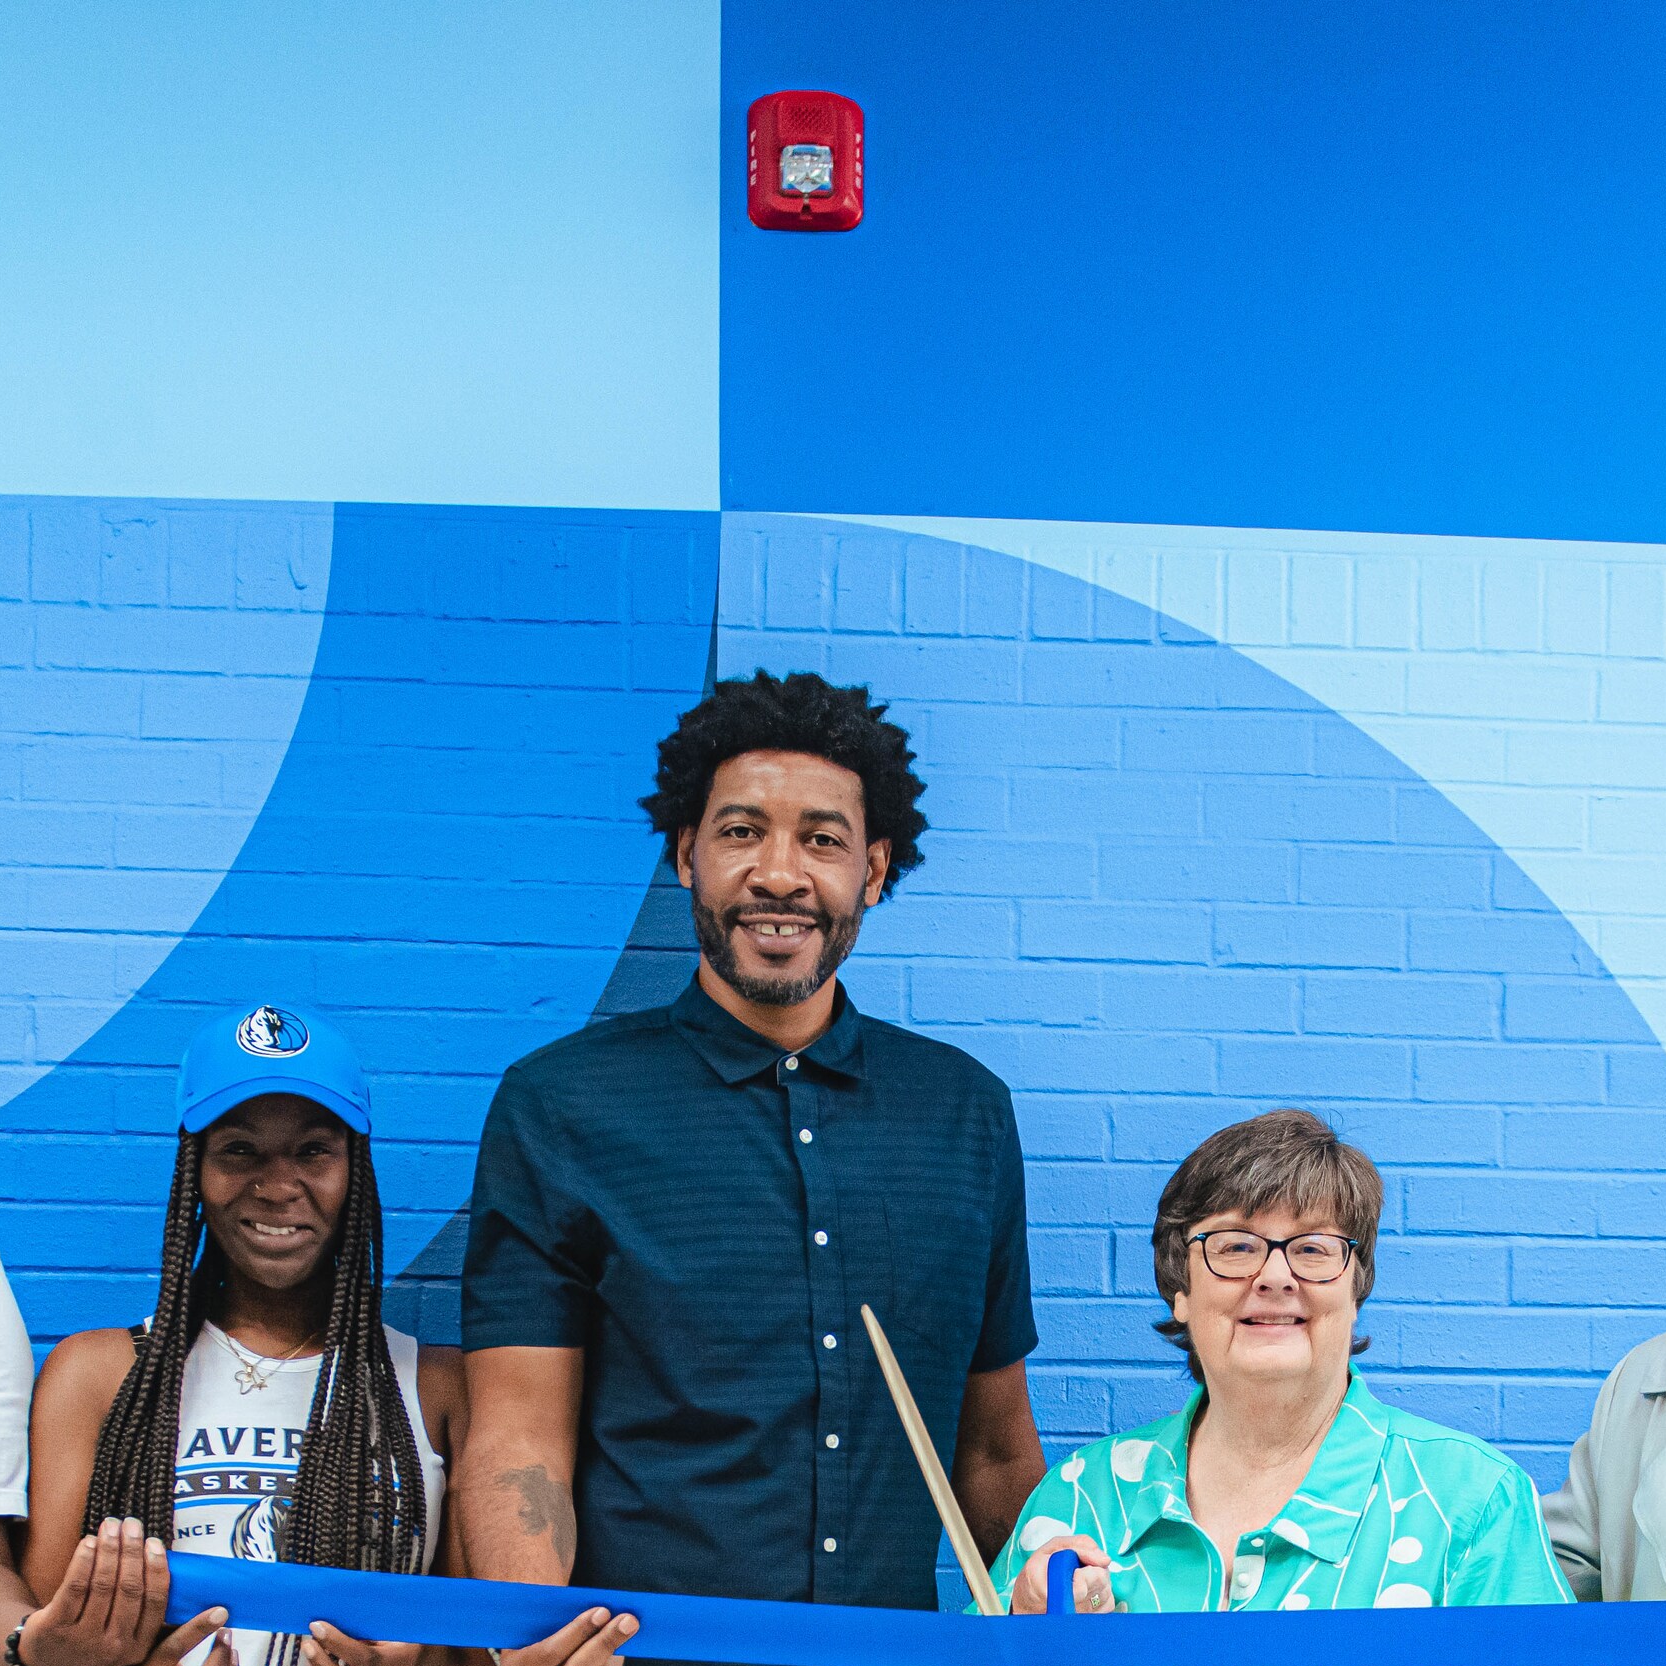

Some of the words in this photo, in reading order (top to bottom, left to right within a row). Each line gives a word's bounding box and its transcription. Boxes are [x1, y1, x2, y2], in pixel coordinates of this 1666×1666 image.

[181, 1426, 306, 1459] AVER
[174, 1474, 298, 1495] ASKE
[176, 1523, 217, 1540] NCE
